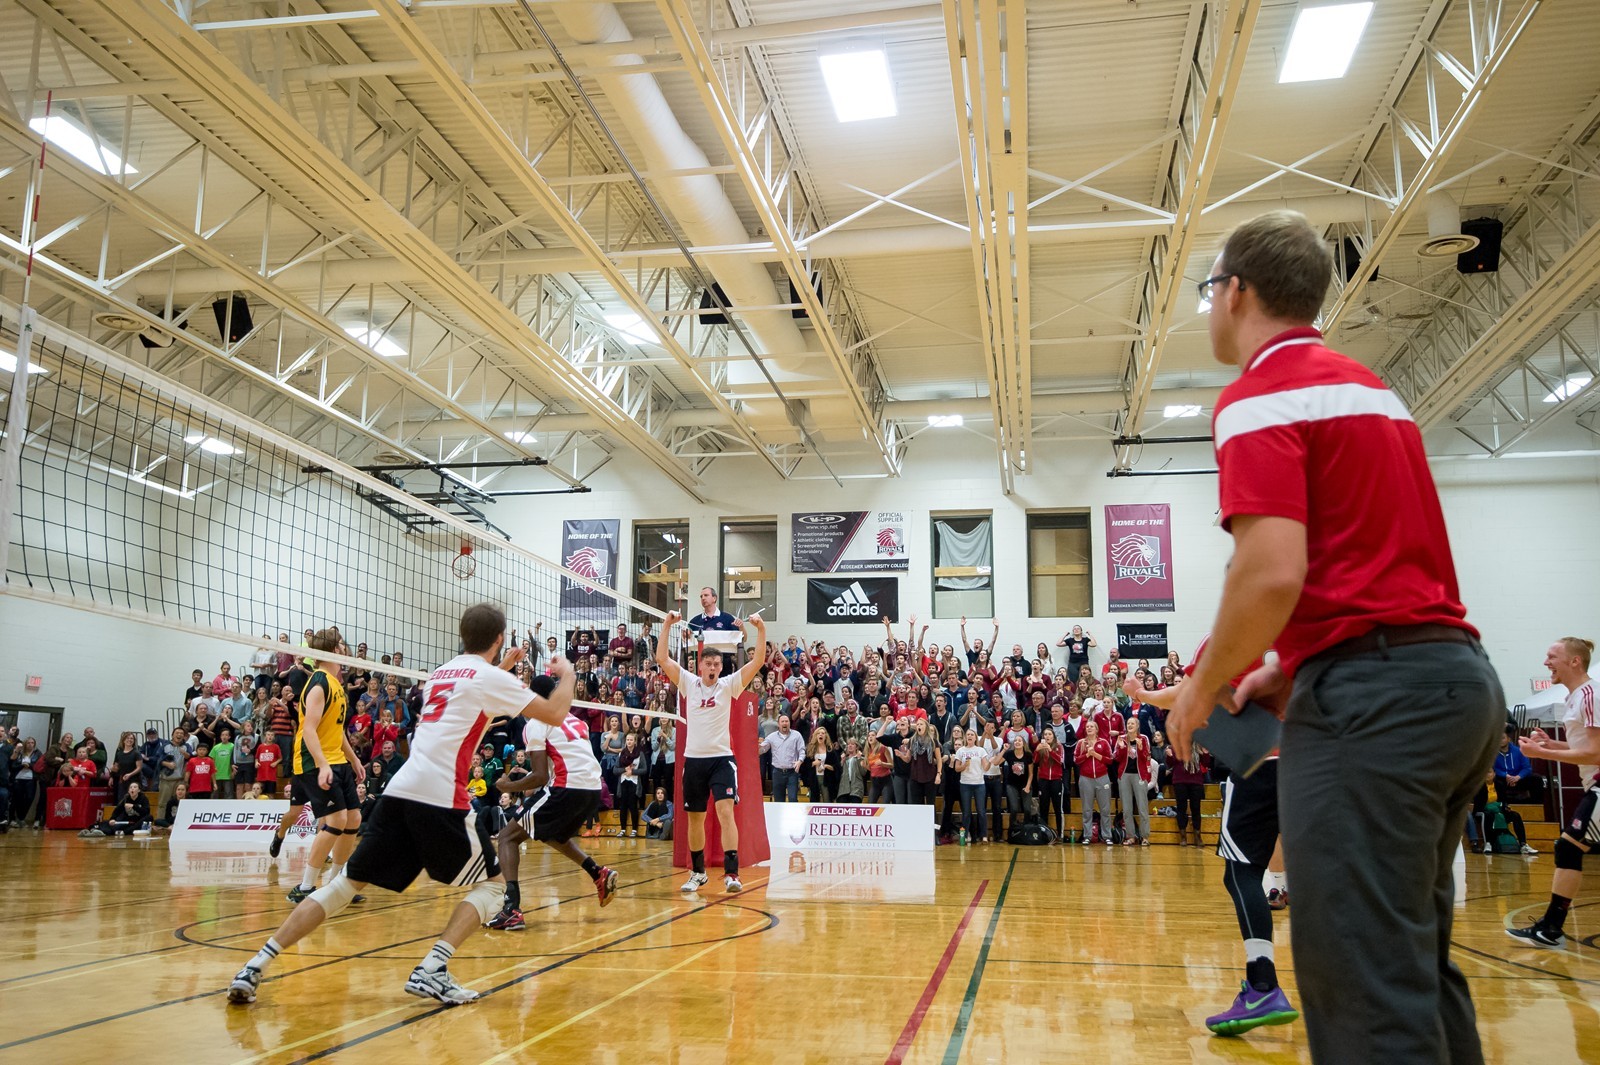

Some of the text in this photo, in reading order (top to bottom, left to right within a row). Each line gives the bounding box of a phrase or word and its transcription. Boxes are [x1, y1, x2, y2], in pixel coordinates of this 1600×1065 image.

[1119, 566, 1161, 577] ROYALS
[827, 602, 878, 616] adidas
[1119, 634, 1128, 645] R
[430, 667, 478, 680] EDEEMER
[421, 681, 457, 723] 5
[336, 703, 345, 725] 3
[812, 807, 872, 816] WELCOME TO
[193, 813, 284, 823] HOME OF THE
[291, 825, 317, 834] ROYALS
[809, 823, 895, 838] REDEEMER
[808, 840, 857, 848] UNIVERSITY
